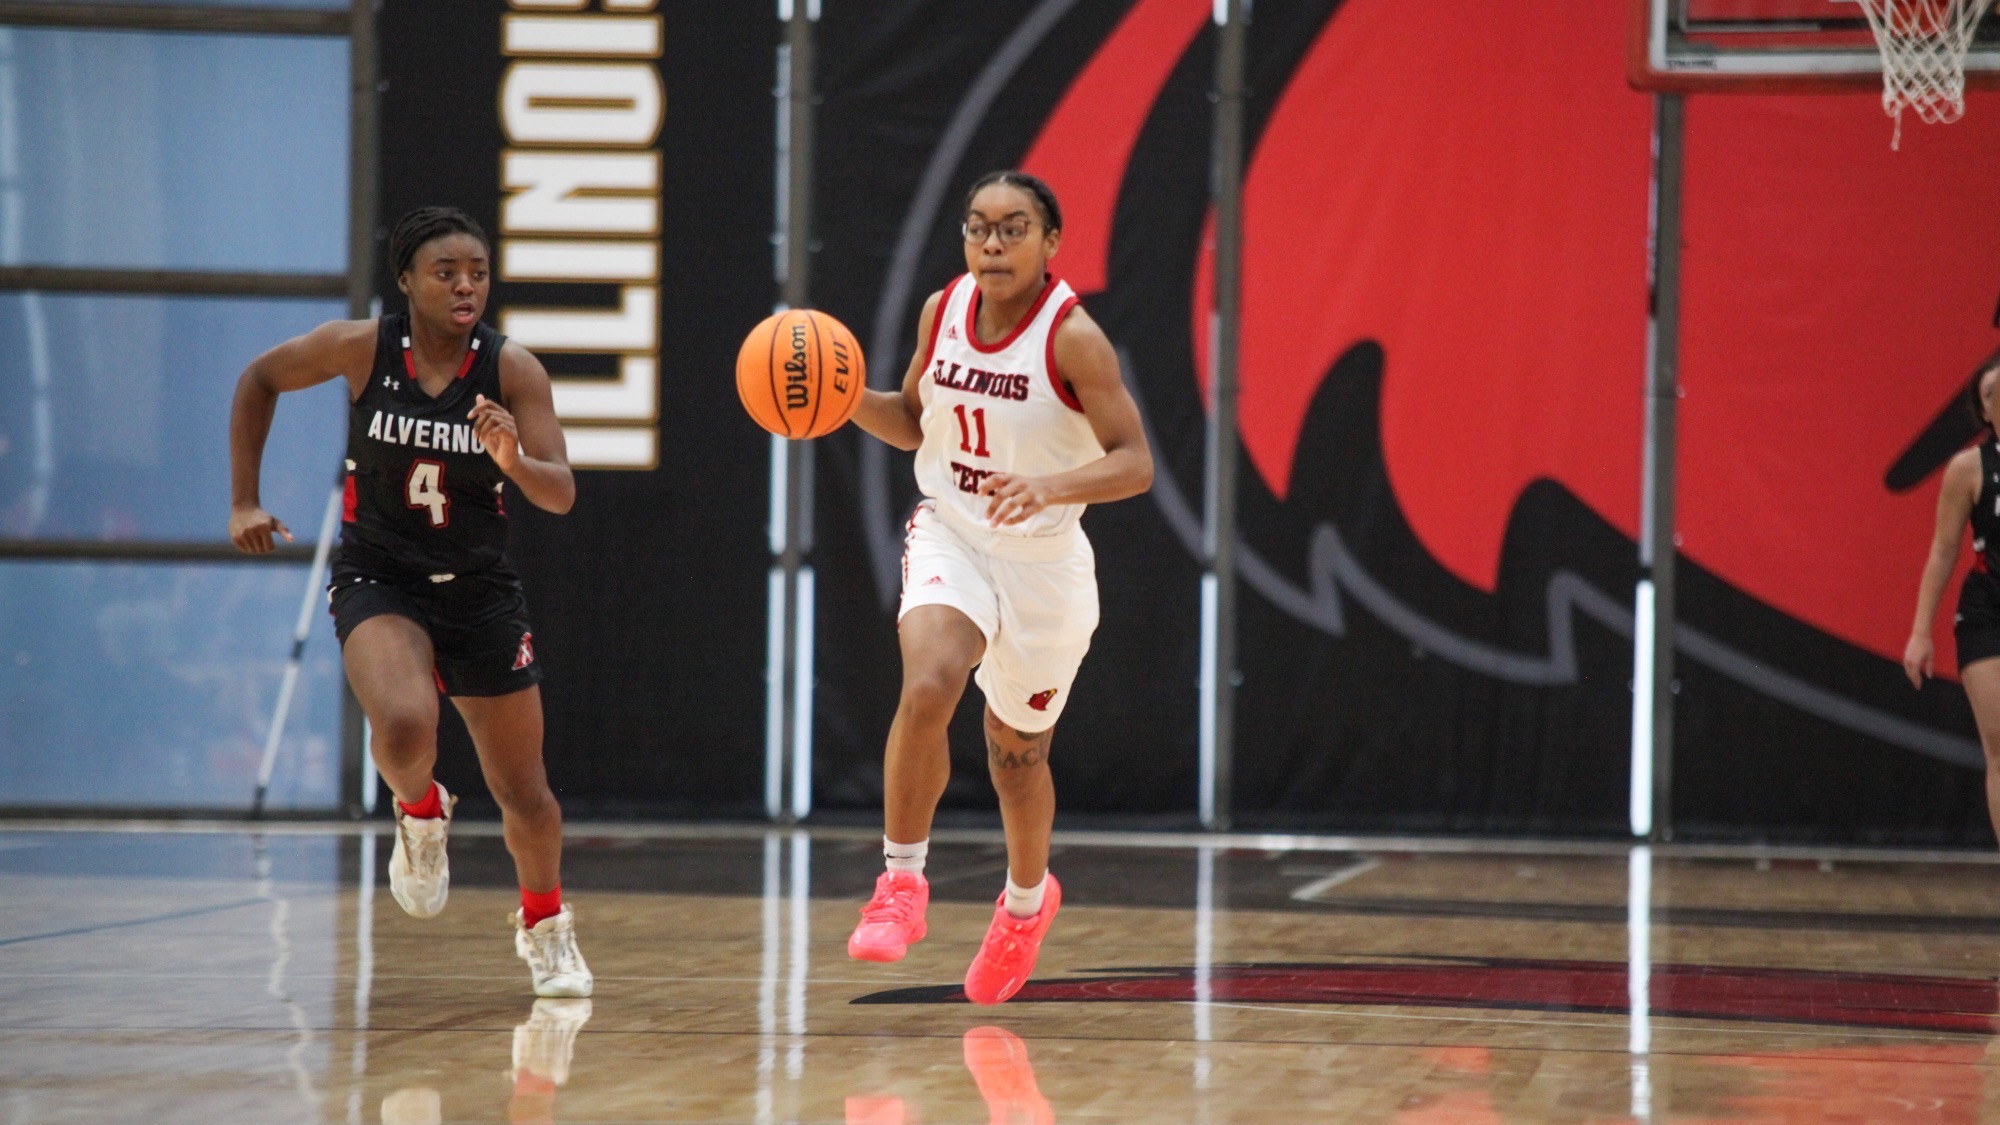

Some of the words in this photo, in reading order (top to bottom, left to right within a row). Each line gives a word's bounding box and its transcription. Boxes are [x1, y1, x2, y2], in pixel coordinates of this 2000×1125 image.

[501, 0, 664, 470] ILLINOI
[784, 324, 809, 411] Wilson
[933, 359, 1030, 402] ILLINOIS
[953, 403, 991, 459] 11
[405, 458, 451, 529] 4
[950, 460, 1005, 498] TEC
